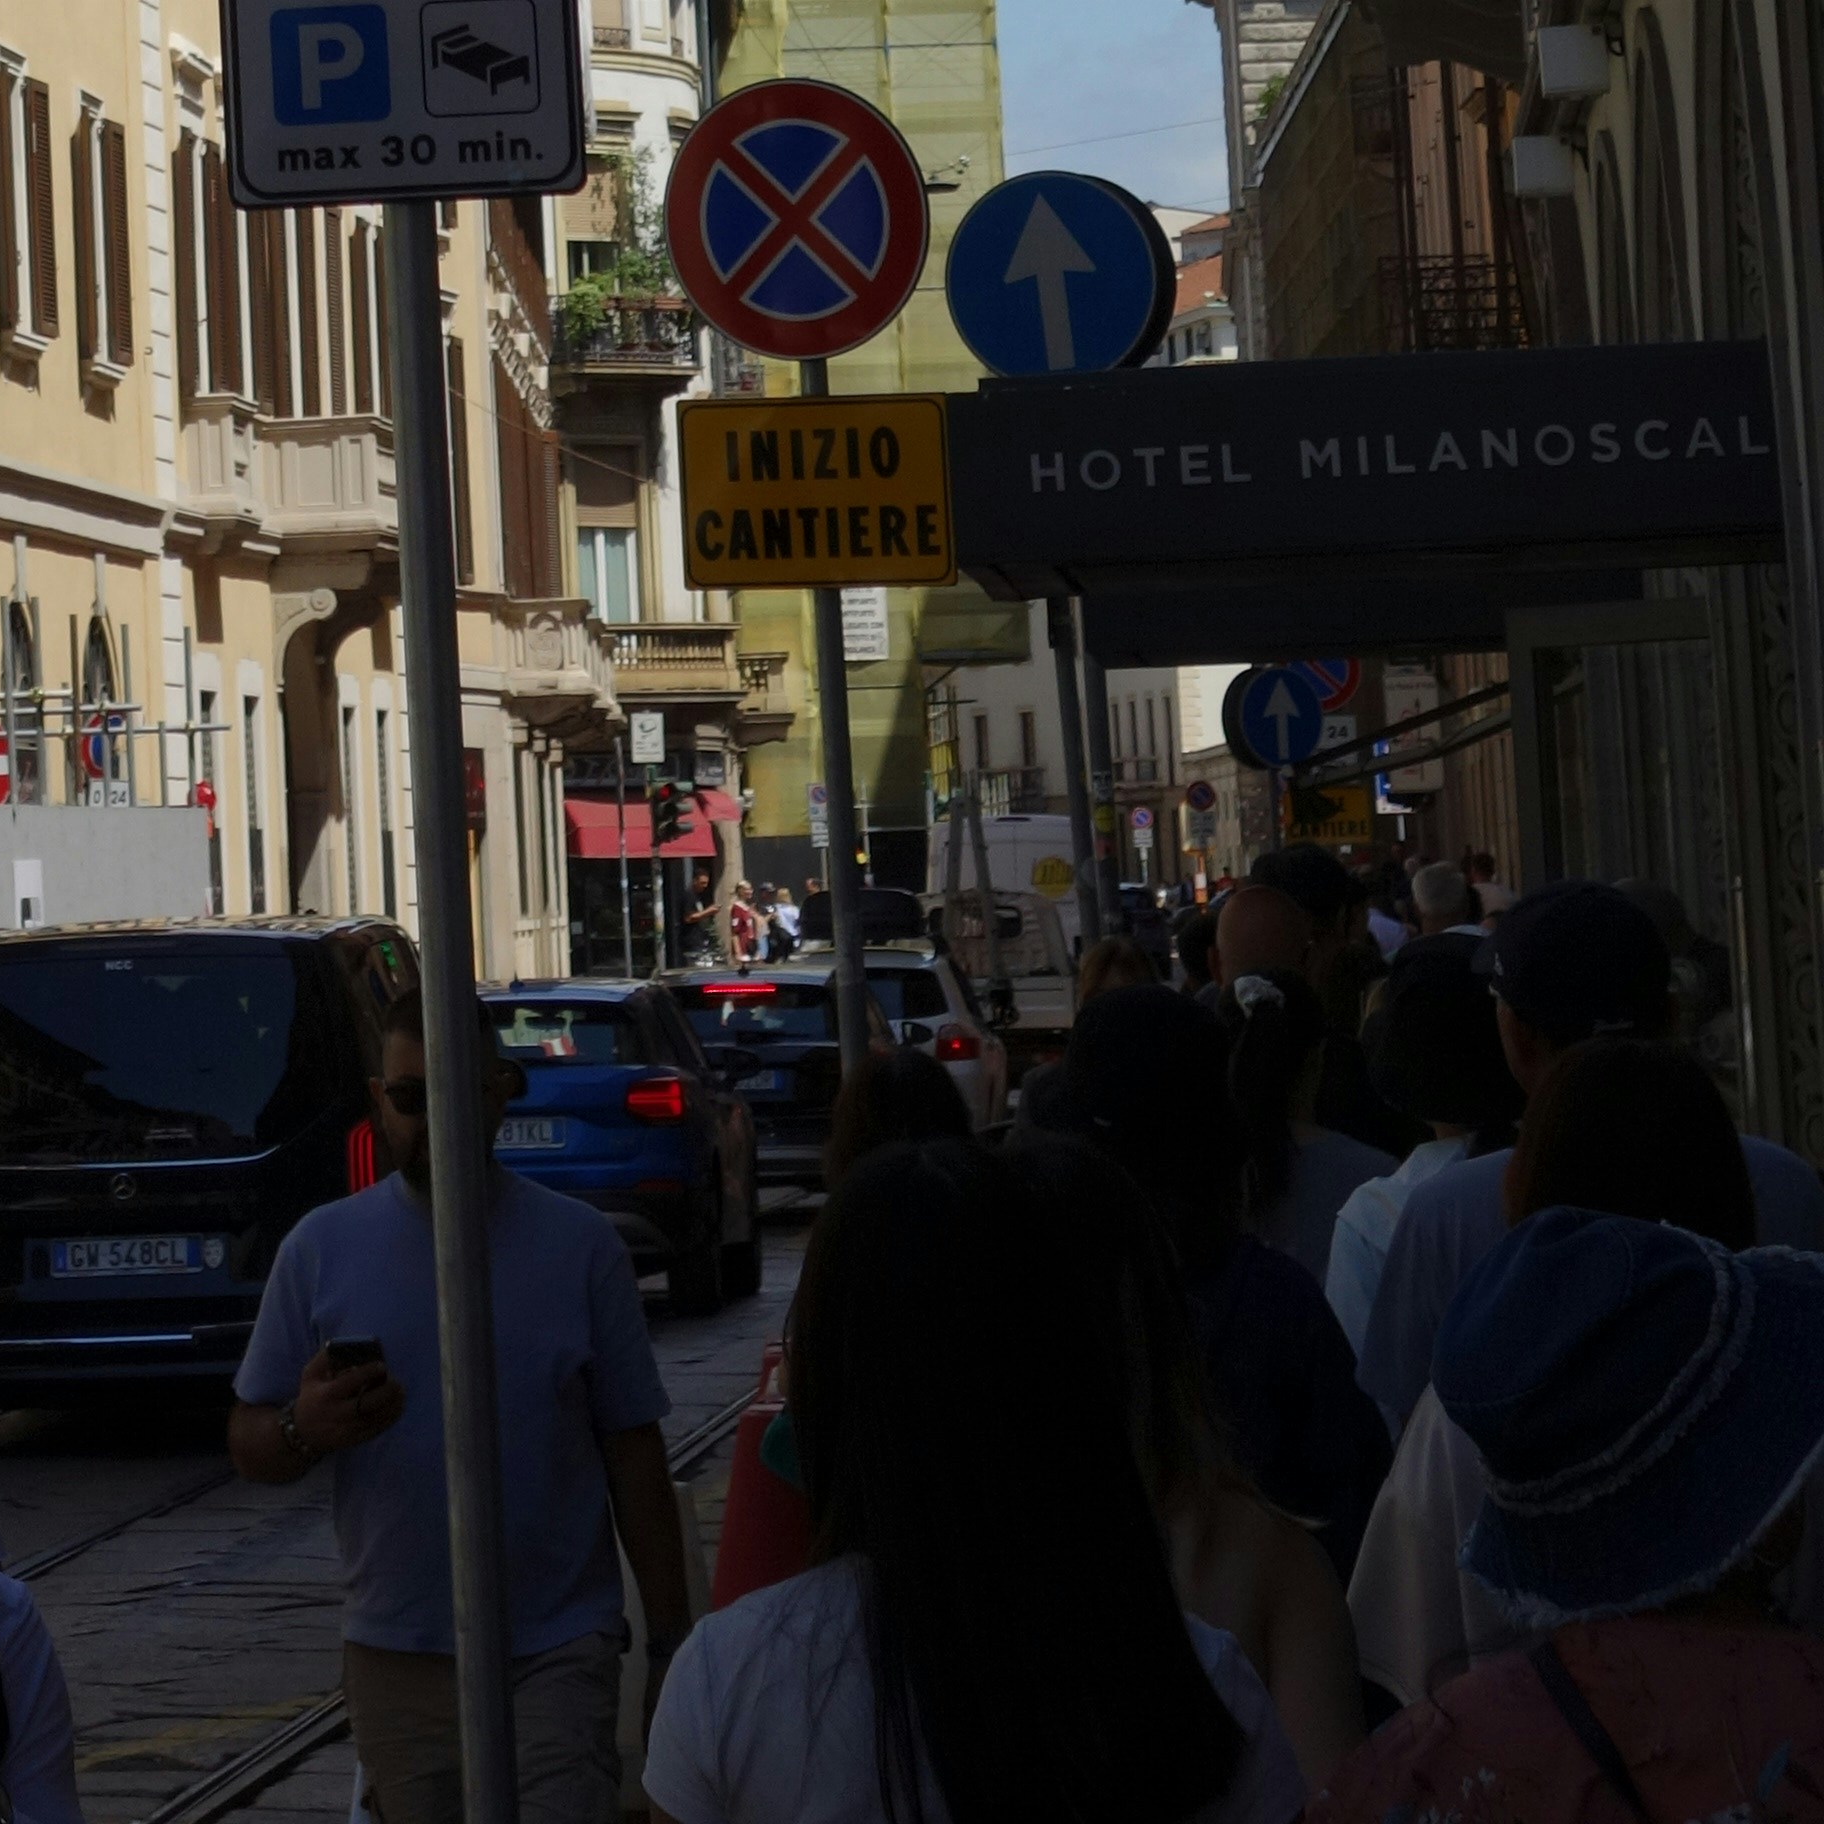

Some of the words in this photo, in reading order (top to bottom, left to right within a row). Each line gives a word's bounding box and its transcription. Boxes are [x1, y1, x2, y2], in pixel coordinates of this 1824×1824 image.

[297, 22, 365, 110] P
[278, 145, 362, 172] max
[380, 134, 436, 167] 30
[458, 131, 543, 164] min.
[726, 426, 900, 482] INIZIO
[1030, 443, 1252, 493] HOTEL
[1298, 415, 1770, 480] MILANOSCAL
[695, 505, 942, 561] CANTIERE
[1328, 725, 1348, 739] 24
[496, 1121, 550, 1142] 81KL
